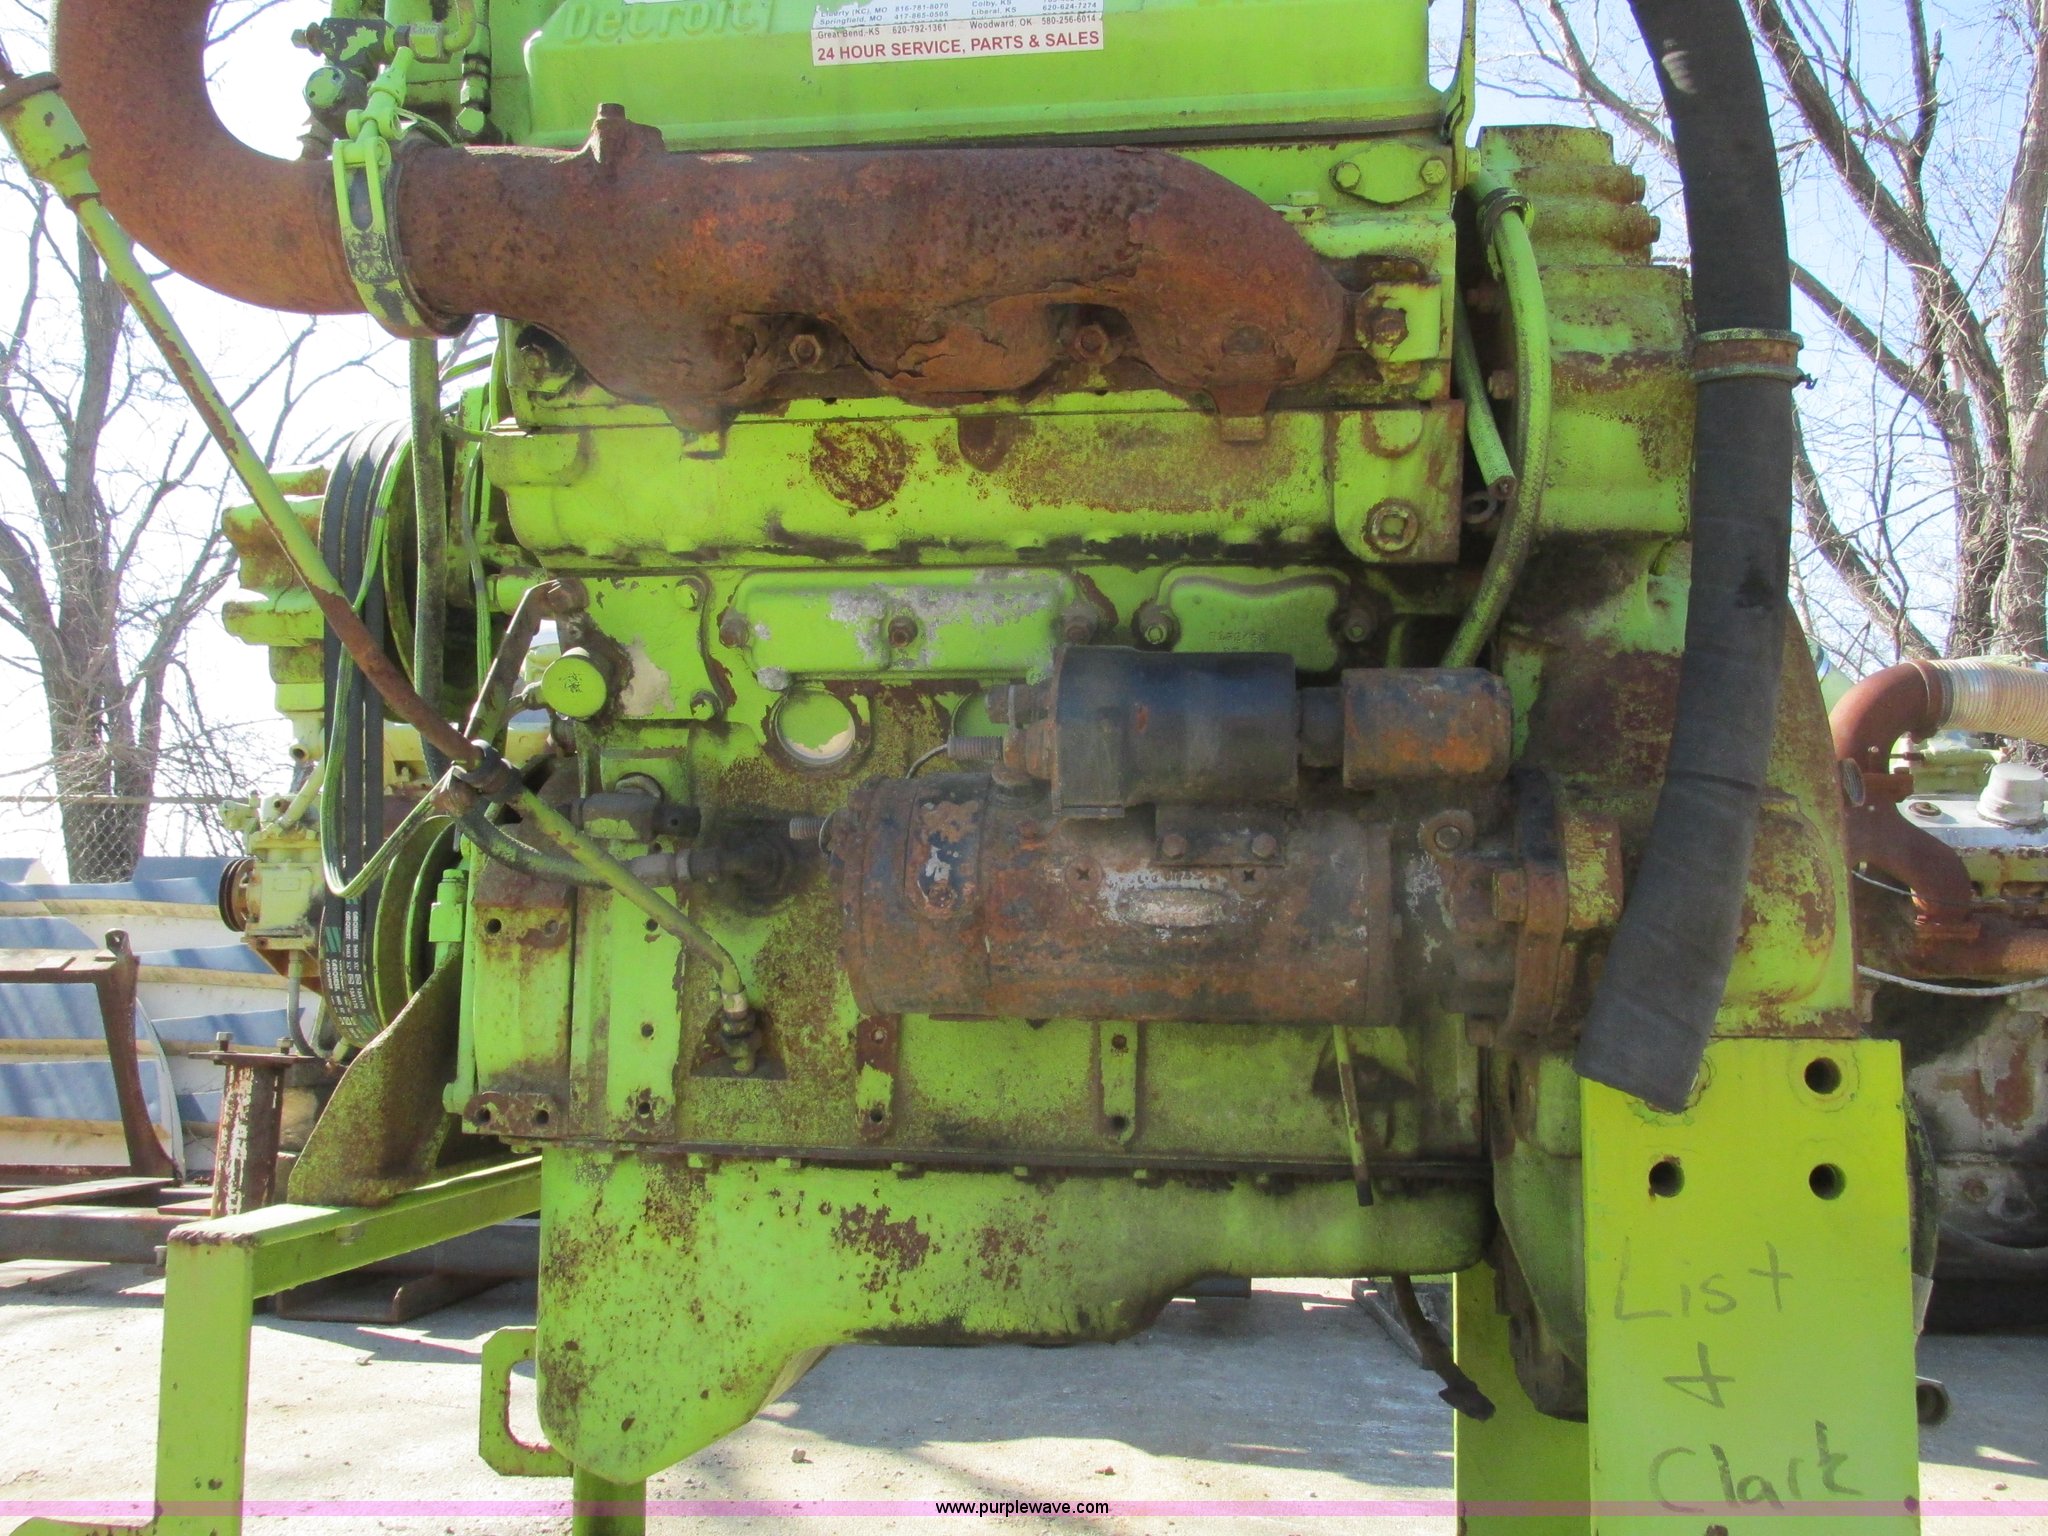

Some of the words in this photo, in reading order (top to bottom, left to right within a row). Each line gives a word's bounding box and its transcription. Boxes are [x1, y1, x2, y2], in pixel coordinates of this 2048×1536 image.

[818, 30, 840, 39] Great
[892, 23, 948, 34] 620-792-1361
[969, 19, 1018, 30] Woodward,
[1020, 18, 1033, 27] OK
[1041, 14, 1096, 25] 580-256-6014
[817, 48, 836, 61] 24
[839, 43, 887, 59] HOUR
[891, 39, 966, 56] SERVICE,
[971, 35, 1024, 51] PARTS
[1029, 34, 1041, 48] &
[1045, 30, 1100, 47] SALES
[1614, 1236, 1794, 1321] List
[1648, 1420, 1865, 1513] Clark
